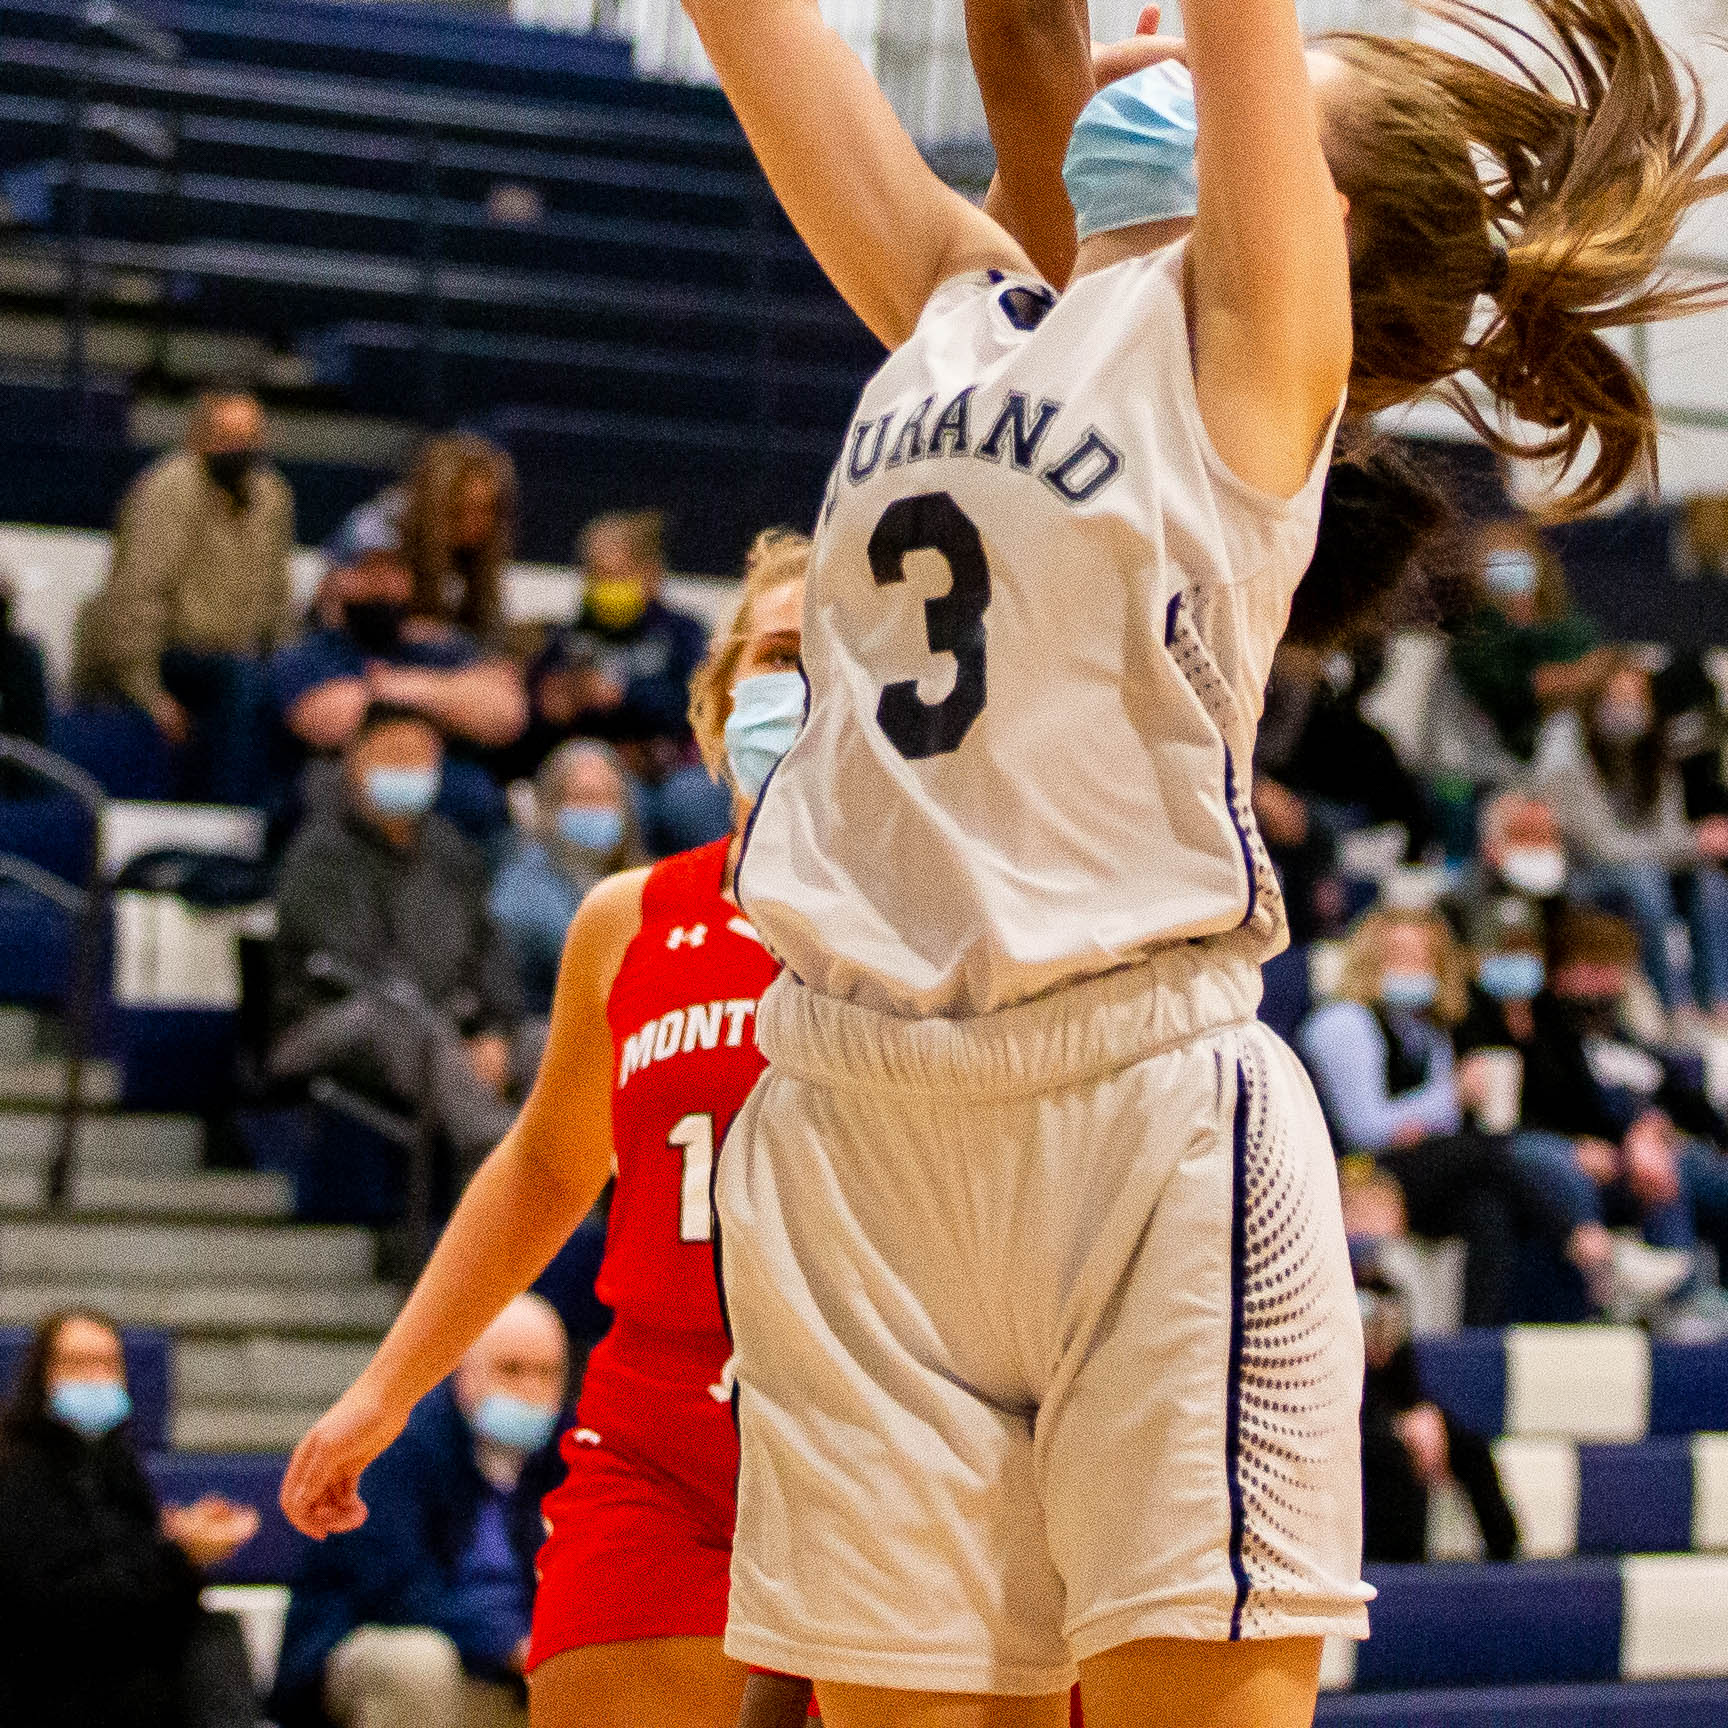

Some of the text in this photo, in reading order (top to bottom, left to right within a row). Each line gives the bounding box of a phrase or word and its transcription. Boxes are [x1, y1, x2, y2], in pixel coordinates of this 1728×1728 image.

[822, 385, 1126, 522] URAND
[867, 490, 992, 760] 3
[618, 996, 762, 1090] MONT
